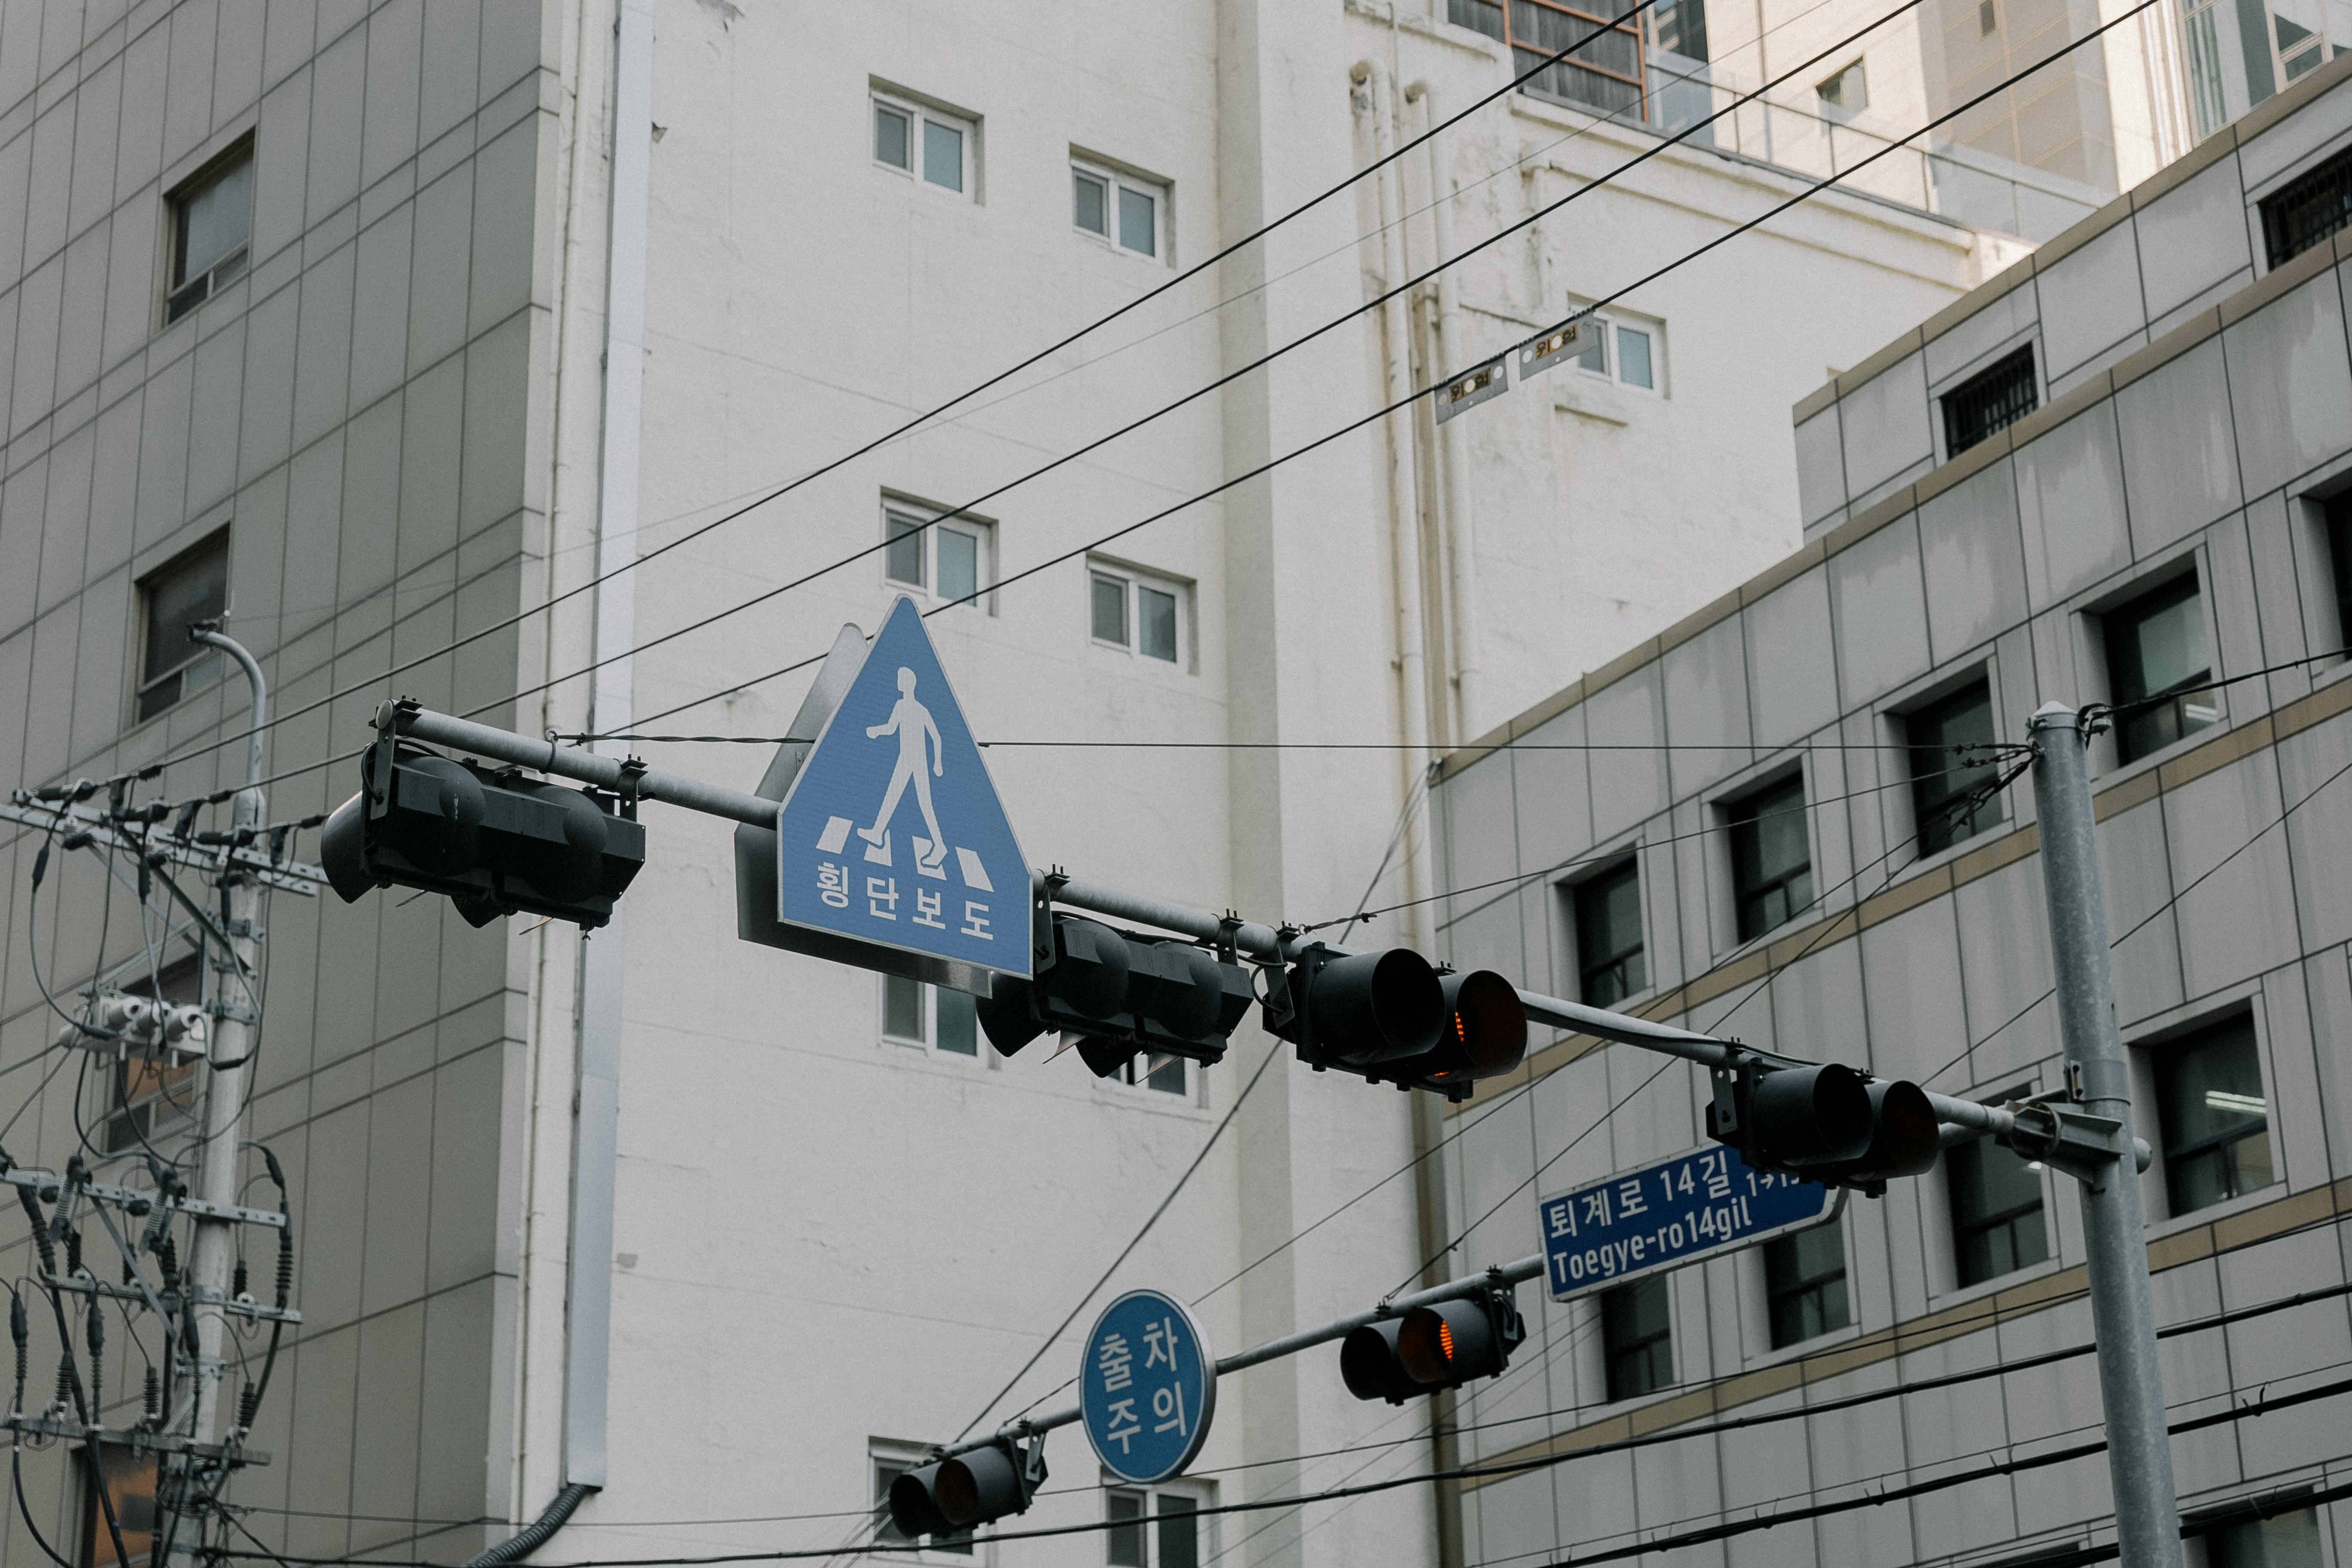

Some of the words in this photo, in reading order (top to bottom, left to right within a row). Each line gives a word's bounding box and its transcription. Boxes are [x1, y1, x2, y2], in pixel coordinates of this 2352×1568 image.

[817, 861, 994, 940] 횡단보도
[1550, 1179, 1648, 1238] 퇴계로
[1660, 1150, 1731, 1201] 14길
[1099, 1317, 1179, 1393] 출차
[1107, 1381, 1187, 1455] 주의
